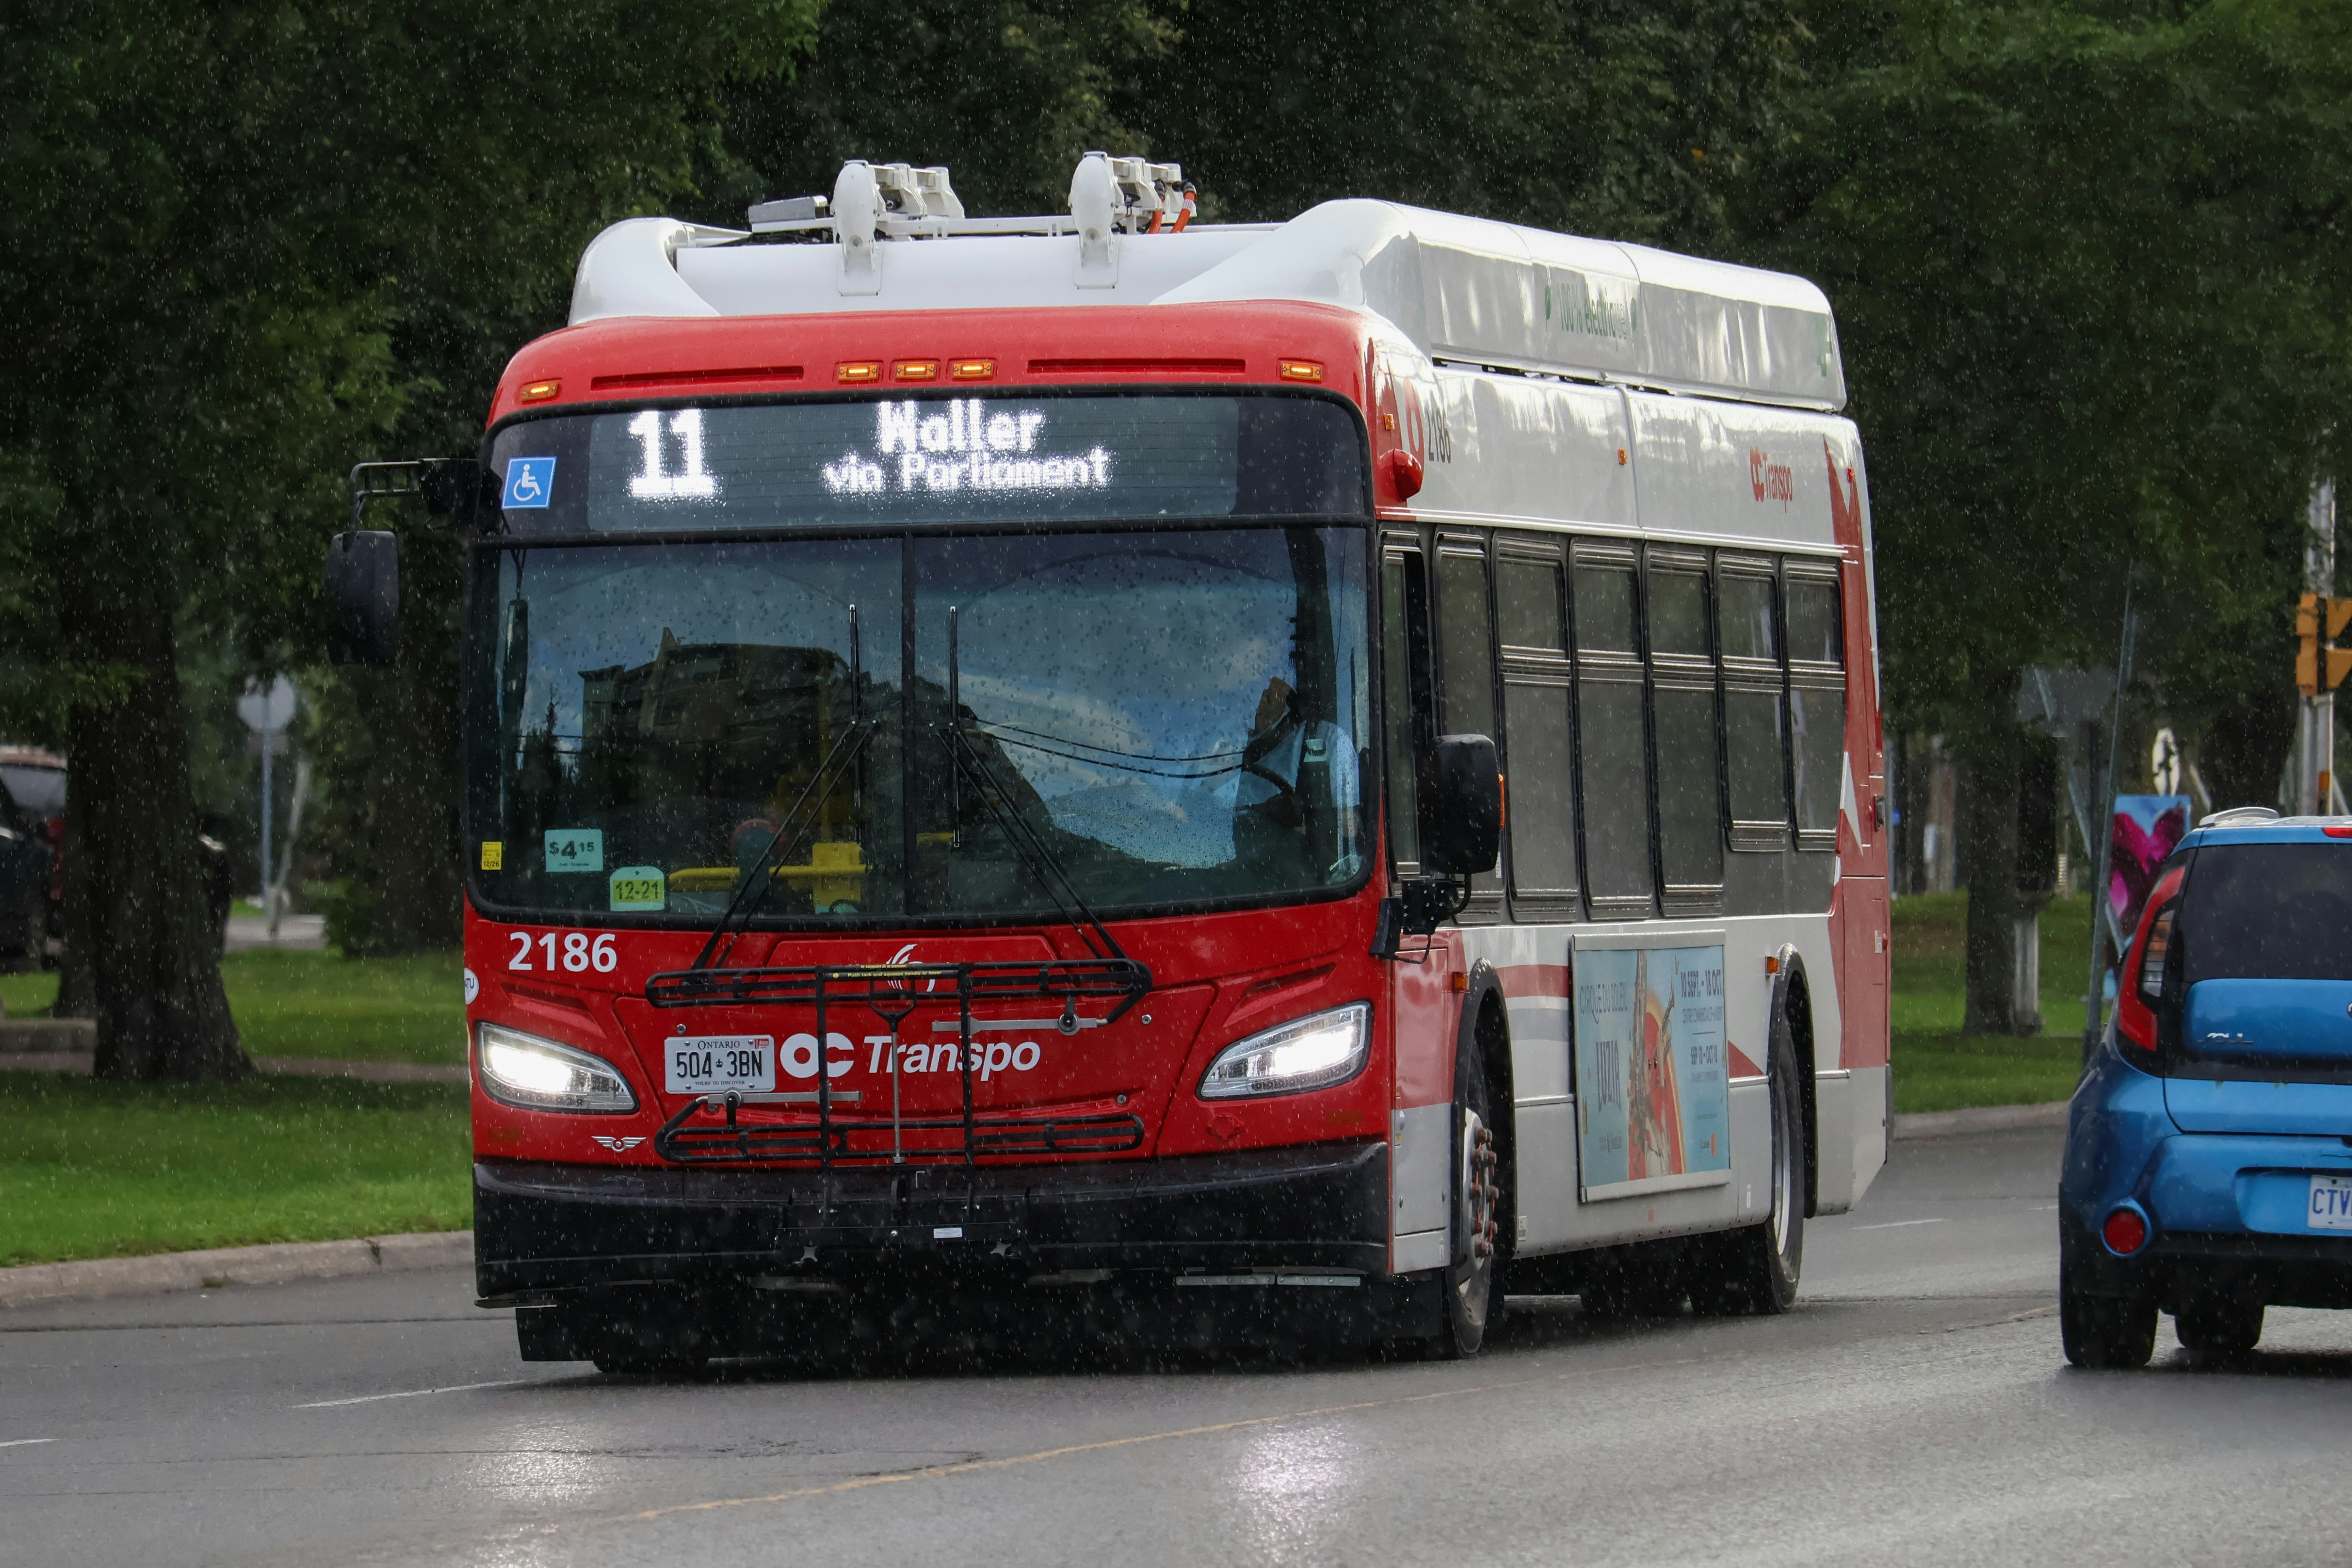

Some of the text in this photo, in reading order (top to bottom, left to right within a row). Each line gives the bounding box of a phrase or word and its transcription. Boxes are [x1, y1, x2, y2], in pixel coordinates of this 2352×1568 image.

[877, 399, 1044, 453] Waller
[1424, 400, 1451, 464] 2186
[628, 409, 715, 498] 11
[822, 446, 1108, 492] via Parliament
[1750, 446, 1793, 514] OC Transpo
[615, 880, 659, 900] 12-21
[508, 931, 617, 973] 2186
[1580, 983, 1602, 1025] CIRQUE
[1602, 983, 1611, 1013] DU
[1681, 971, 1687, 998] 10
[1687, 971, 1701, 997] SEPT.
[1705, 970, 1712, 997] 18
[780, 1032, 1041, 1081] OC Transpo
[2197, 1032, 2254, 1045] SOUL
[676, 1050, 763, 1078] 504 3BN
[1596, 1040, 1621, 1112] LUZIA
[2312, 1188, 2352, 1216] CTV
